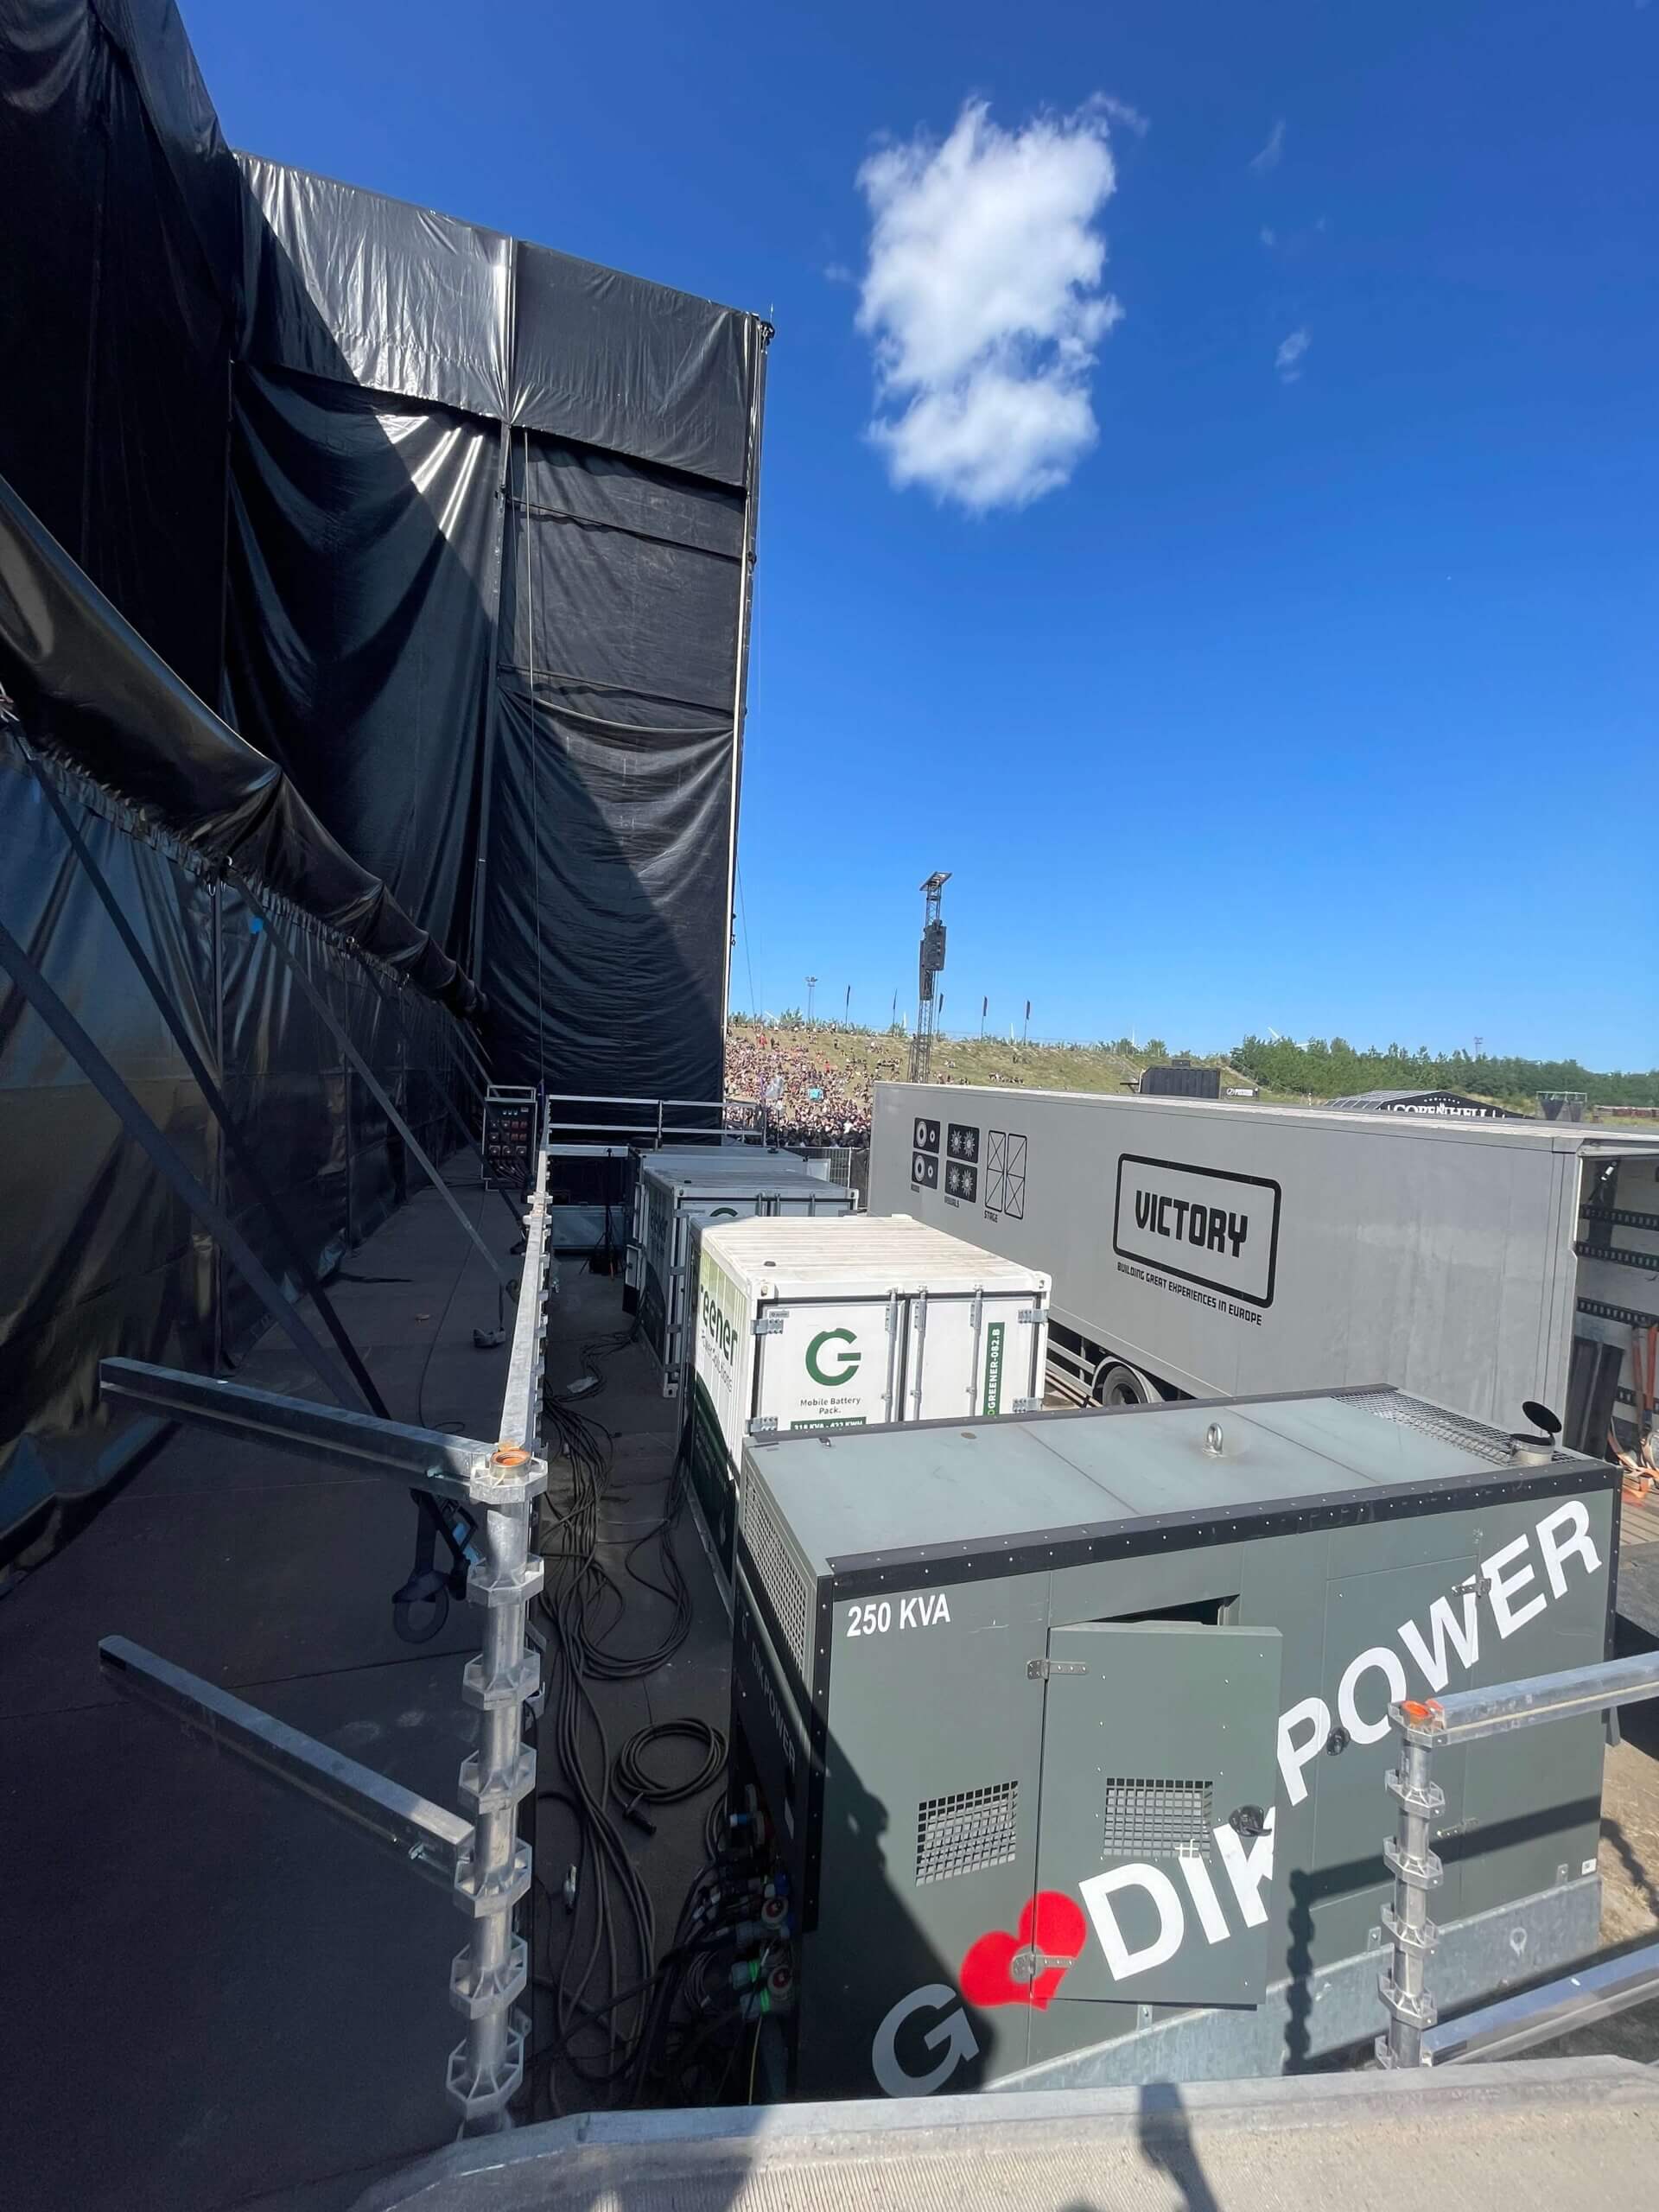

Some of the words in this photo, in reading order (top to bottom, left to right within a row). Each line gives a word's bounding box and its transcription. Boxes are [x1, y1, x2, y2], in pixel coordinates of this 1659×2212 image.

[1135, 1190, 1249, 1258] VICTORY
[1117, 1262, 1146, 1281] BUILDING
[1146, 1273, 1167, 1289] GREAT
[1168, 1281, 1217, 1308] EXPERIENCES
[1218, 1299, 1227, 1313] IN
[1228, 1303, 1262, 1326] EUROPE
[800, 1398, 829, 1407] Mobile
[830, 1396, 861, 1406] Battery
[846, 1602, 892, 1637] 250
[899, 1593, 950, 1630] KVA
[1277, 1499, 1603, 1807] POWER
